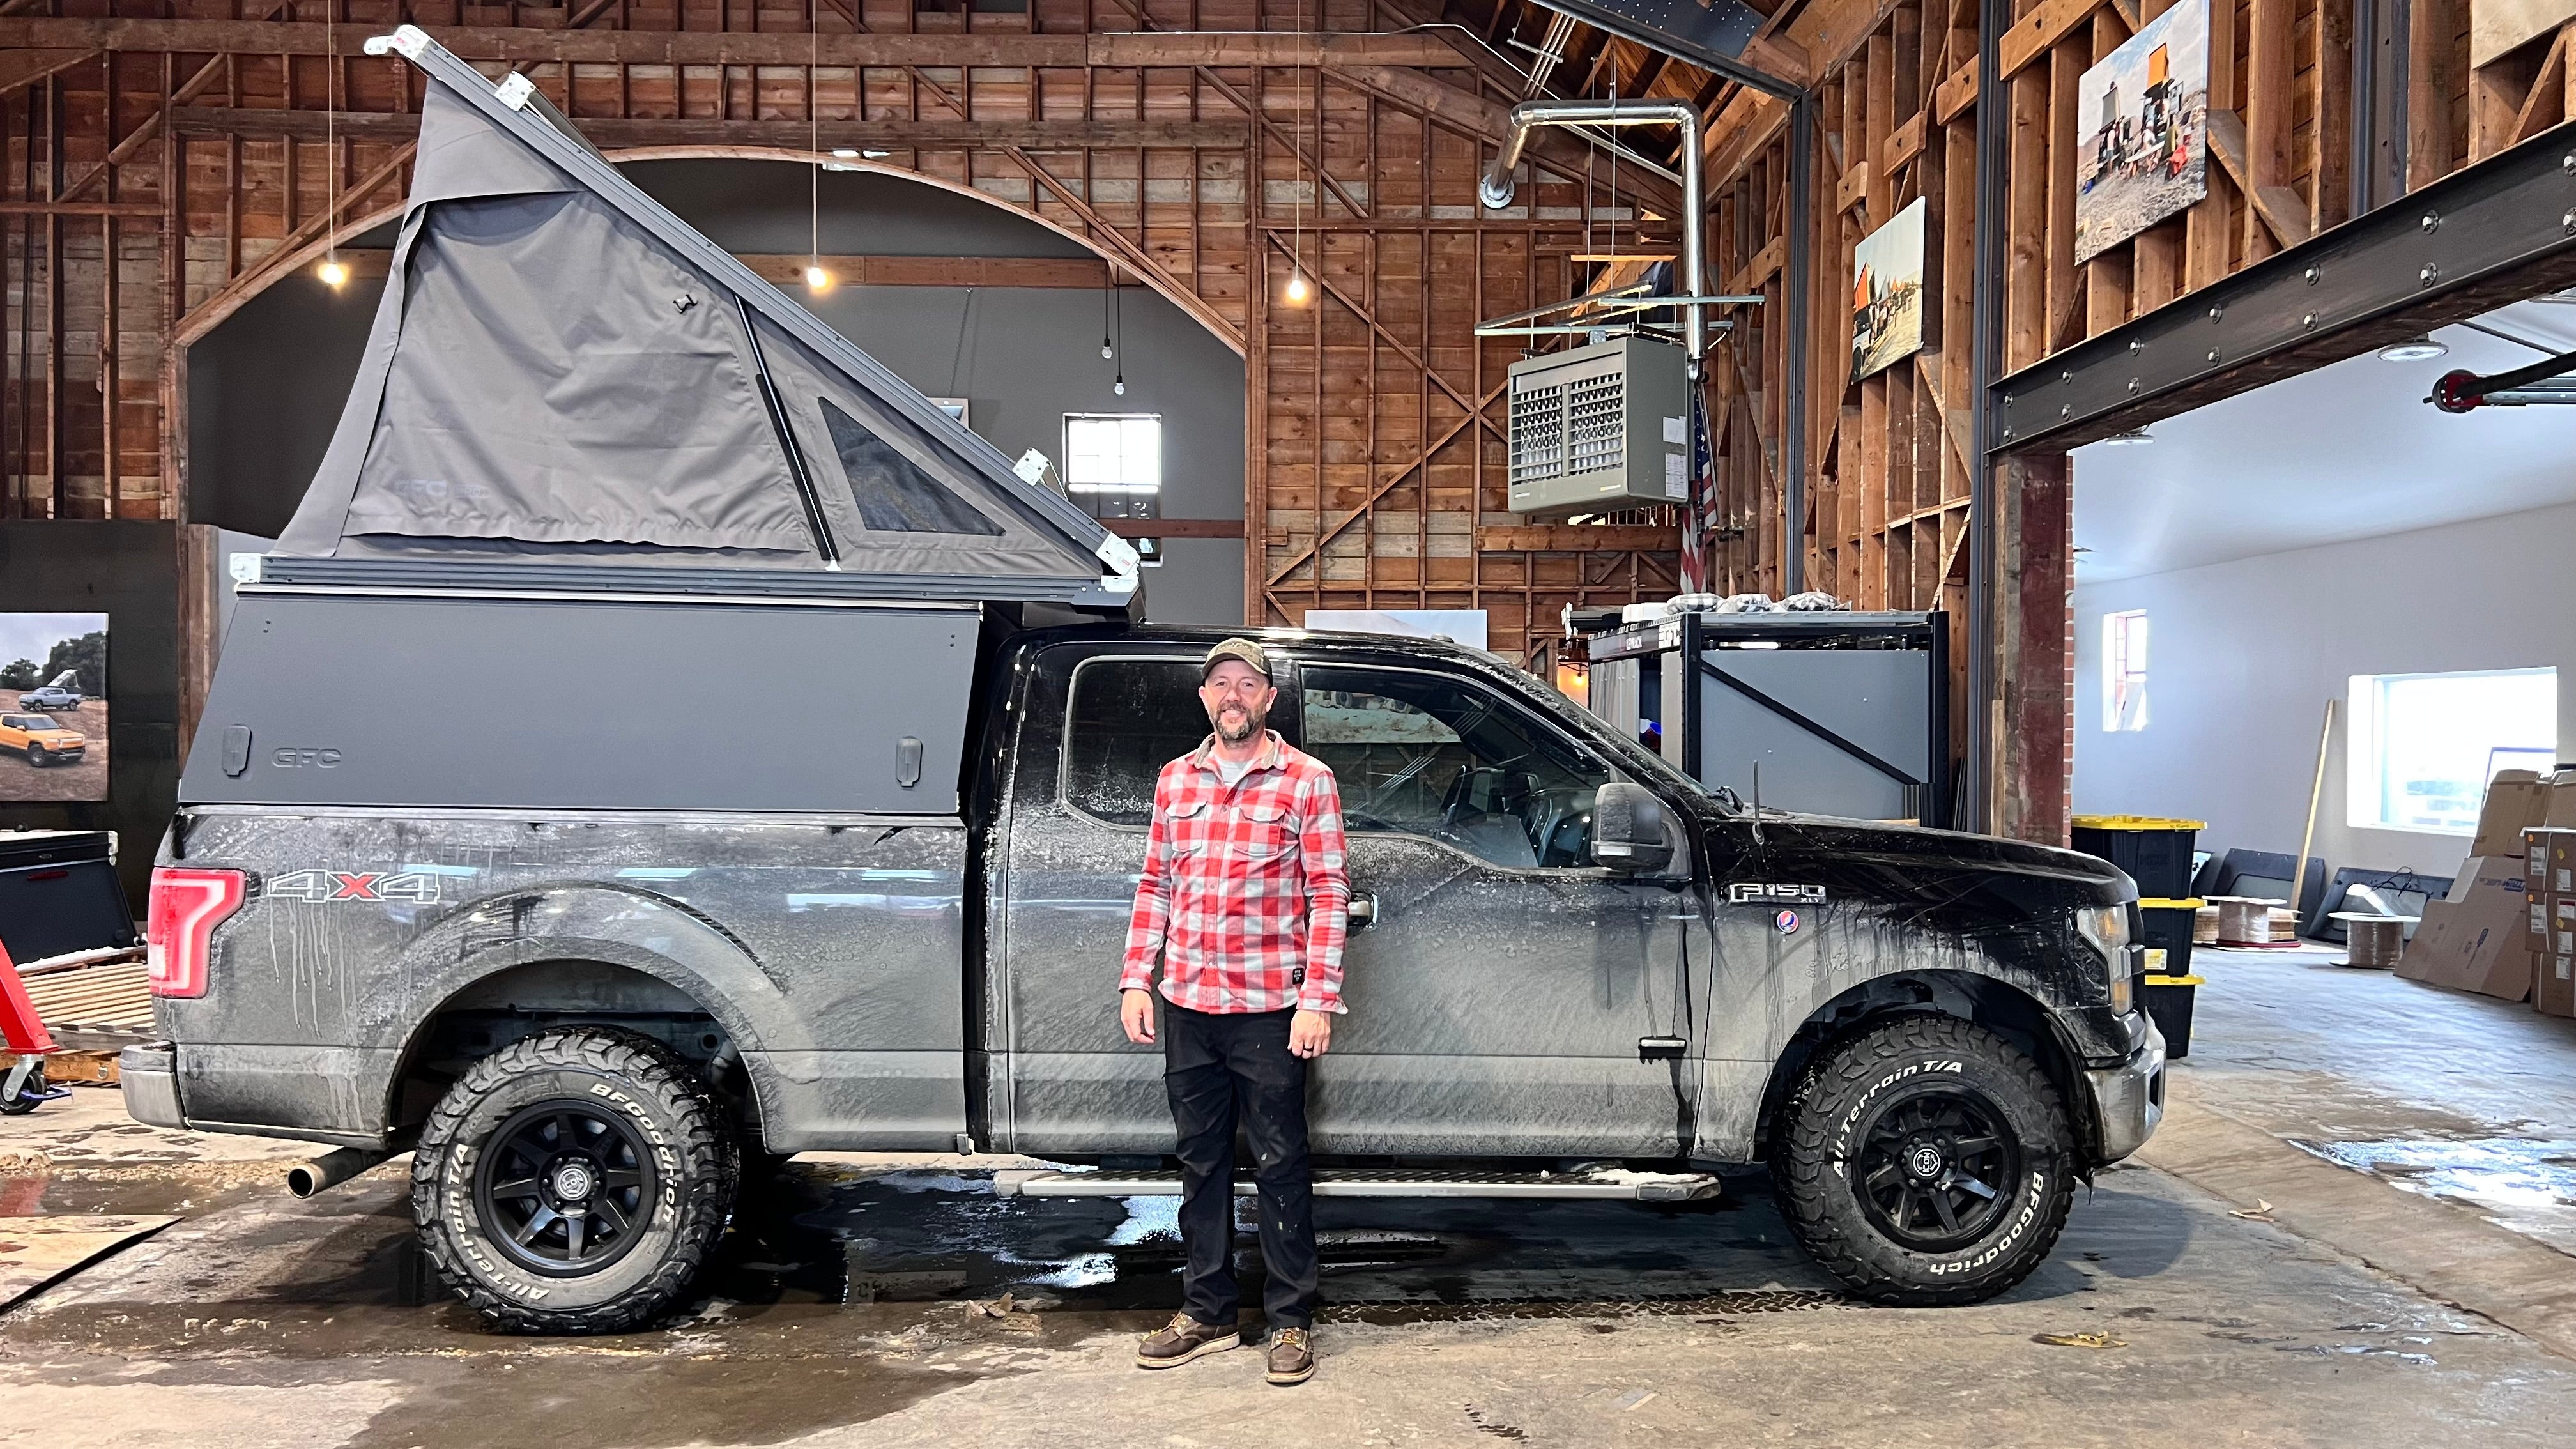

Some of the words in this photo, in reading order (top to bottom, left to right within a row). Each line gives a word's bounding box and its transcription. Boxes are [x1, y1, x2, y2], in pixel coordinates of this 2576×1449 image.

[272, 747, 342, 769] GFC
[590, 1083, 679, 1223] BFGoodrich
[1834, 1065, 1917, 1179] All-Terrain
[1922, 1061, 1963, 1073] T/A
[448, 1143, 470, 1186] T/A
[562, 1174, 585, 1190] ICON
[1922, 1152, 1931, 1173] ICON
[448, 1192, 549, 1300] All-Terrain
[1930, 1172, 2044, 1275] BFGoodrich
